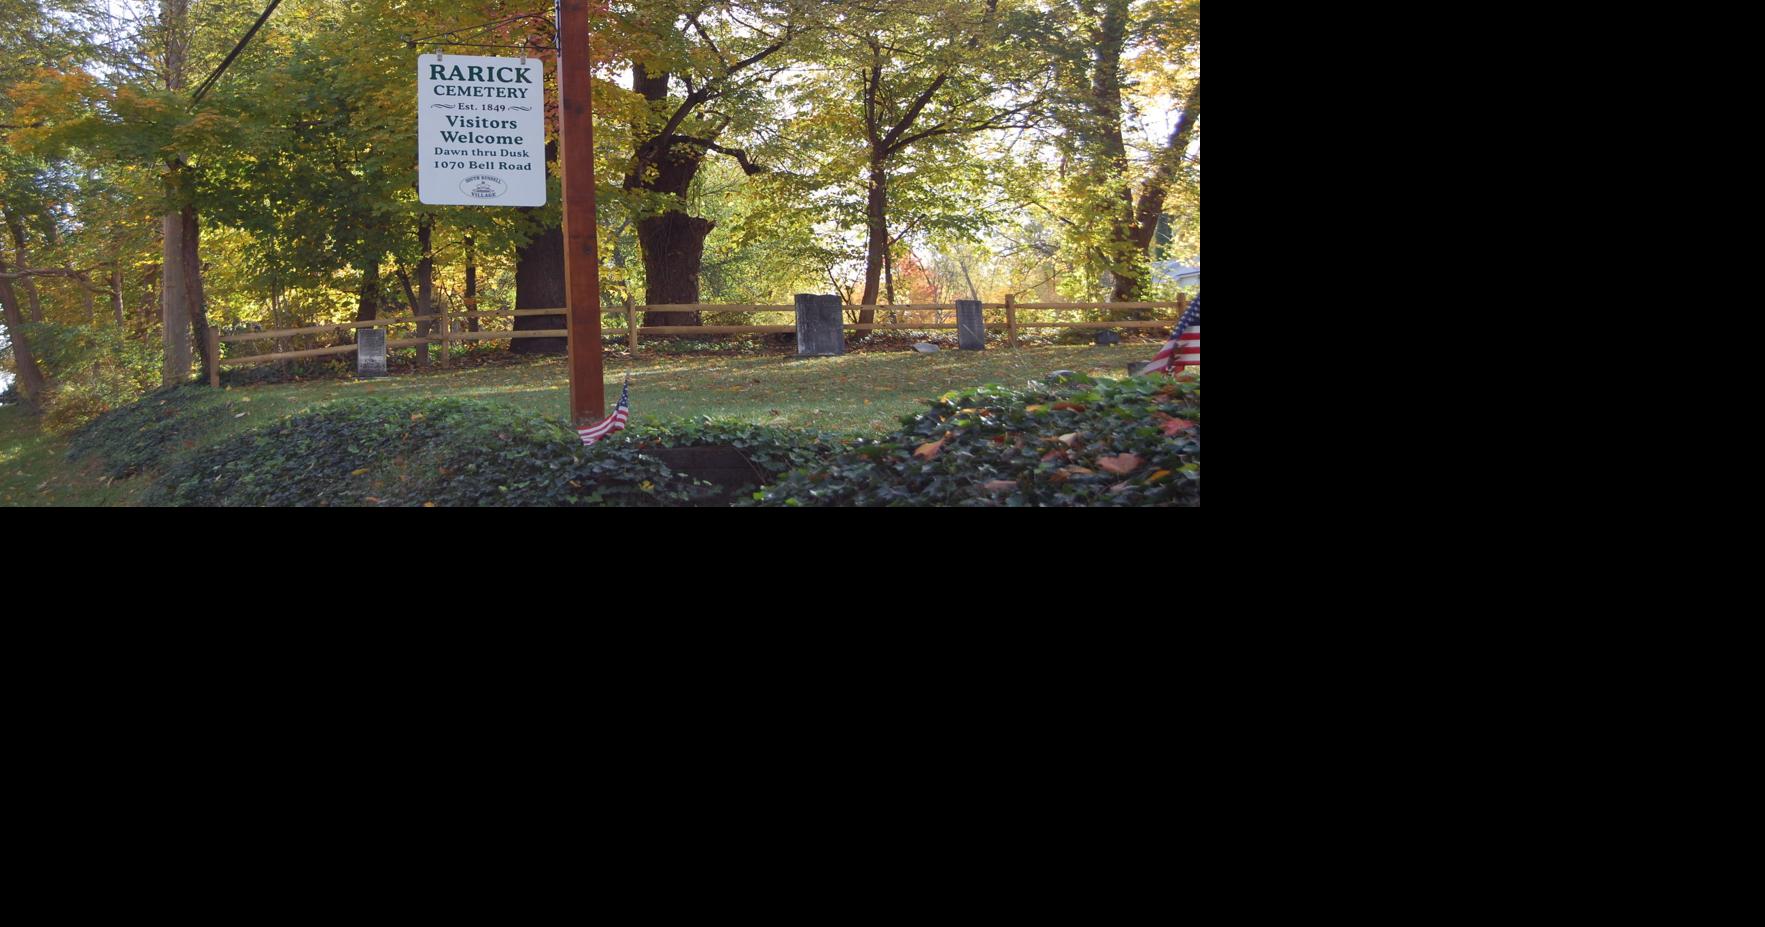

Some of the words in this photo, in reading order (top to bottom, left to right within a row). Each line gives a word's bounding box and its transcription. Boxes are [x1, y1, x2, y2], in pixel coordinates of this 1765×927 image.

[429, 64, 532, 84] RARICK
[433, 85, 528, 98] CEMETERY
[458, 103, 478, 111] Est.
[482, 104, 506, 112] 1849
[446, 115, 517, 129] Visitors
[440, 131, 523, 145] Welcome
[434, 147, 468, 156] Dawn
[472, 149, 497, 157] thru
[500, 149, 529, 157] Dusk
[434, 161, 465, 170] 1070
[469, 161, 494, 170] Bell
[499, 162, 531, 171] Road
